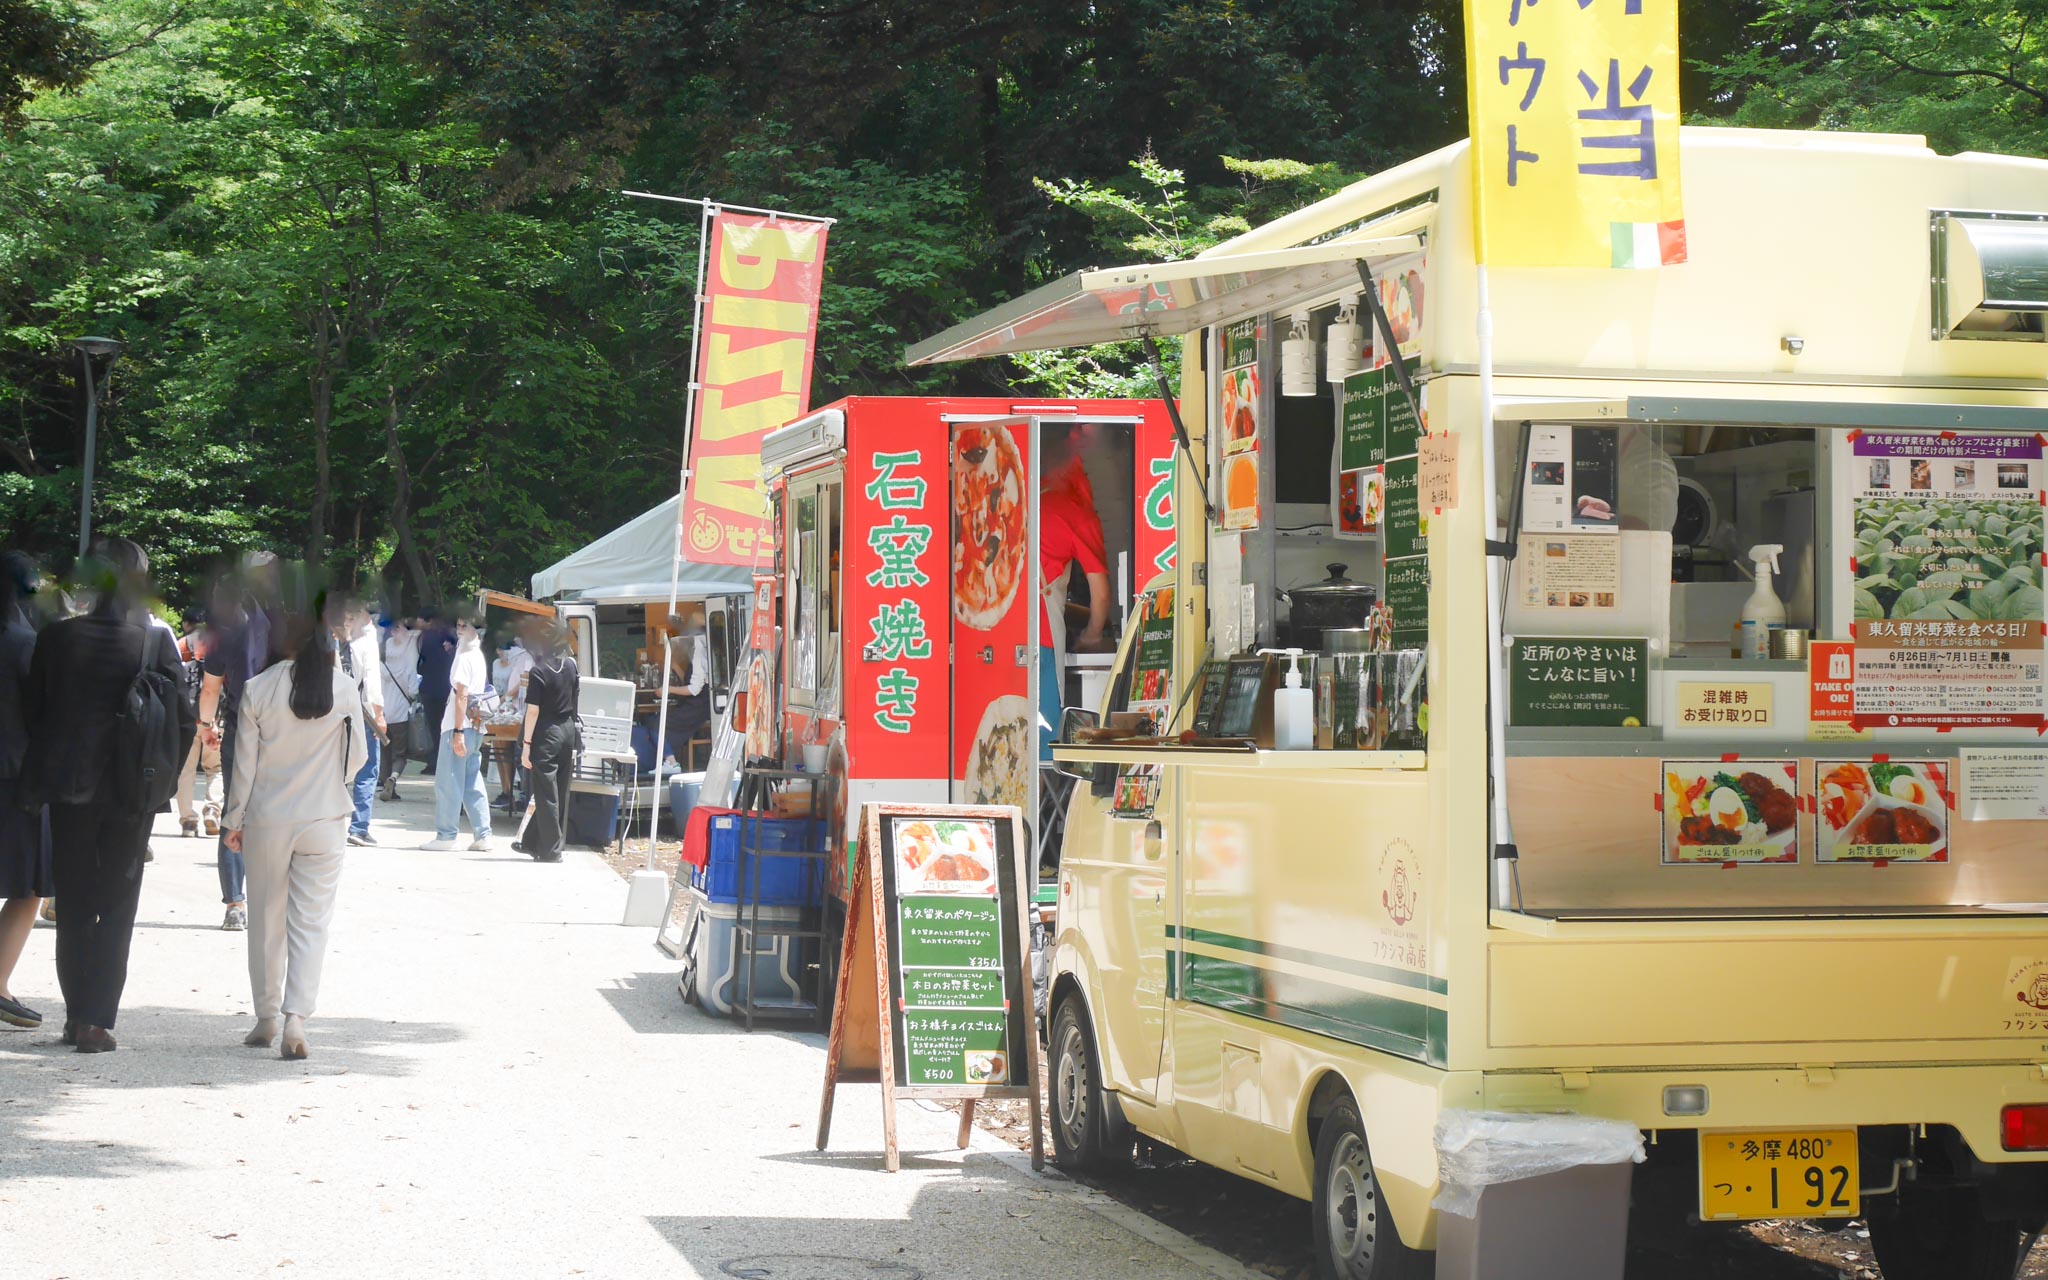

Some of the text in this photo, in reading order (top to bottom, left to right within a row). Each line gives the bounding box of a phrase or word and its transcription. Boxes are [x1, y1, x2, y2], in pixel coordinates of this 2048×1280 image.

[865, 449, 933, 734] 石窯焼き
[1868, 621, 2028, 638] 東久留米野菜を食べる日!
[1522, 645, 1638, 662] 近所のやさいは
[1990, 651, 2012, 662] 開催
[1813, 682, 1842, 692] TAKE
[1703, 690, 1749, 705] 混雑時
[1829, 693, 1849, 703] OK!
[1683, 707, 1768, 723] お受け取り口
[903, 906, 997, 922] 東久留米のポタージュ
[968, 956, 998, 968] ¥350
[1372, 941, 1427, 969] フクシマ商店
[912, 979, 996, 992] 本日のお惣菜セット
[909, 1019, 1004, 1032] お子様チョイスごはん
[923, 1067, 954, 1080] ¥500
[1741, 1138, 1824, 1161] 多摩 480
[1713, 1183, 1733, 1196] つ
